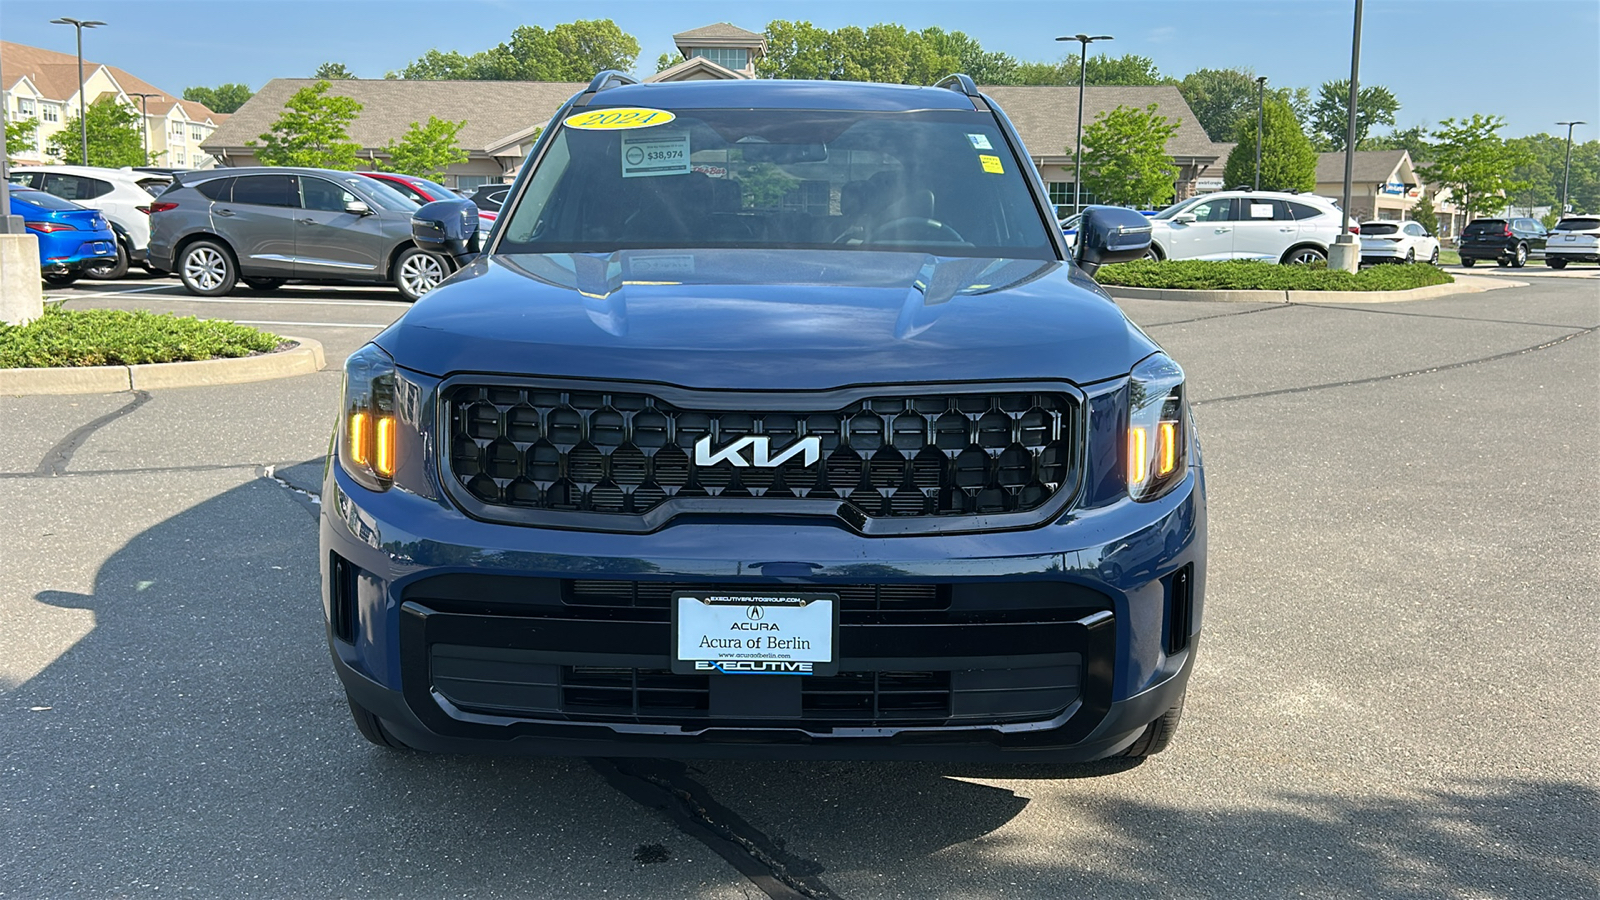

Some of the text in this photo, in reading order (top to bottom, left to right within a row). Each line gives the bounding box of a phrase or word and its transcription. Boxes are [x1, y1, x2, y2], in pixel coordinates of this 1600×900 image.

[580, 112, 659, 126] 2024
[647, 150, 684, 161] $38,974
[695, 434, 822, 468] KIA
[730, 622, 780, 632] ACURA
[699, 635, 811, 650] Acura of Berlin
[695, 661, 813, 671] EXECUTIVE
